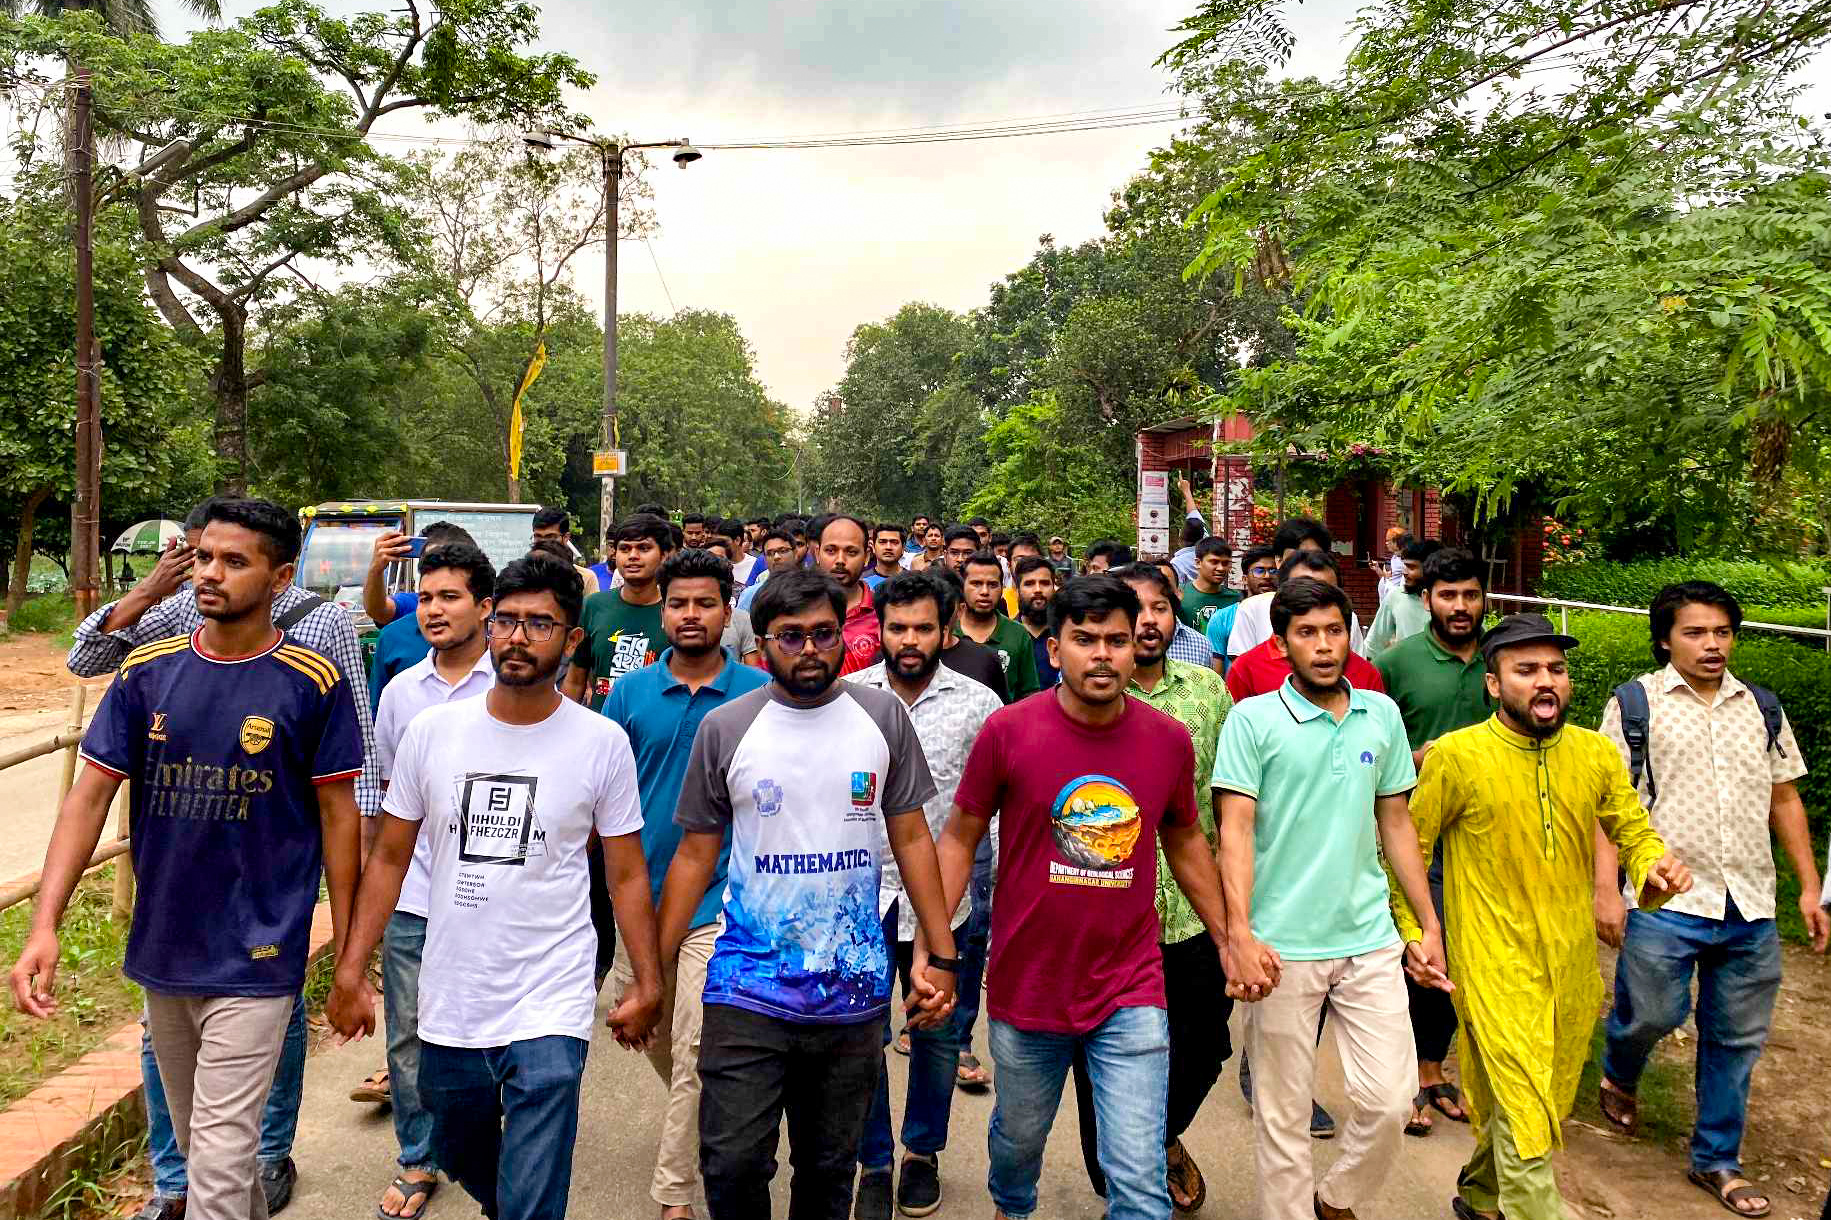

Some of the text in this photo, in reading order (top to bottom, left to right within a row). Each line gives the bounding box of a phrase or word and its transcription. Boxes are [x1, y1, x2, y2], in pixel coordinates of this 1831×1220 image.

[247, 722, 271, 734] Arsenal
[145, 756, 273, 793] Emirates
[754, 848, 872, 875] MATHEMATIC
[1049, 860, 1080, 876] DEPARTMENT
